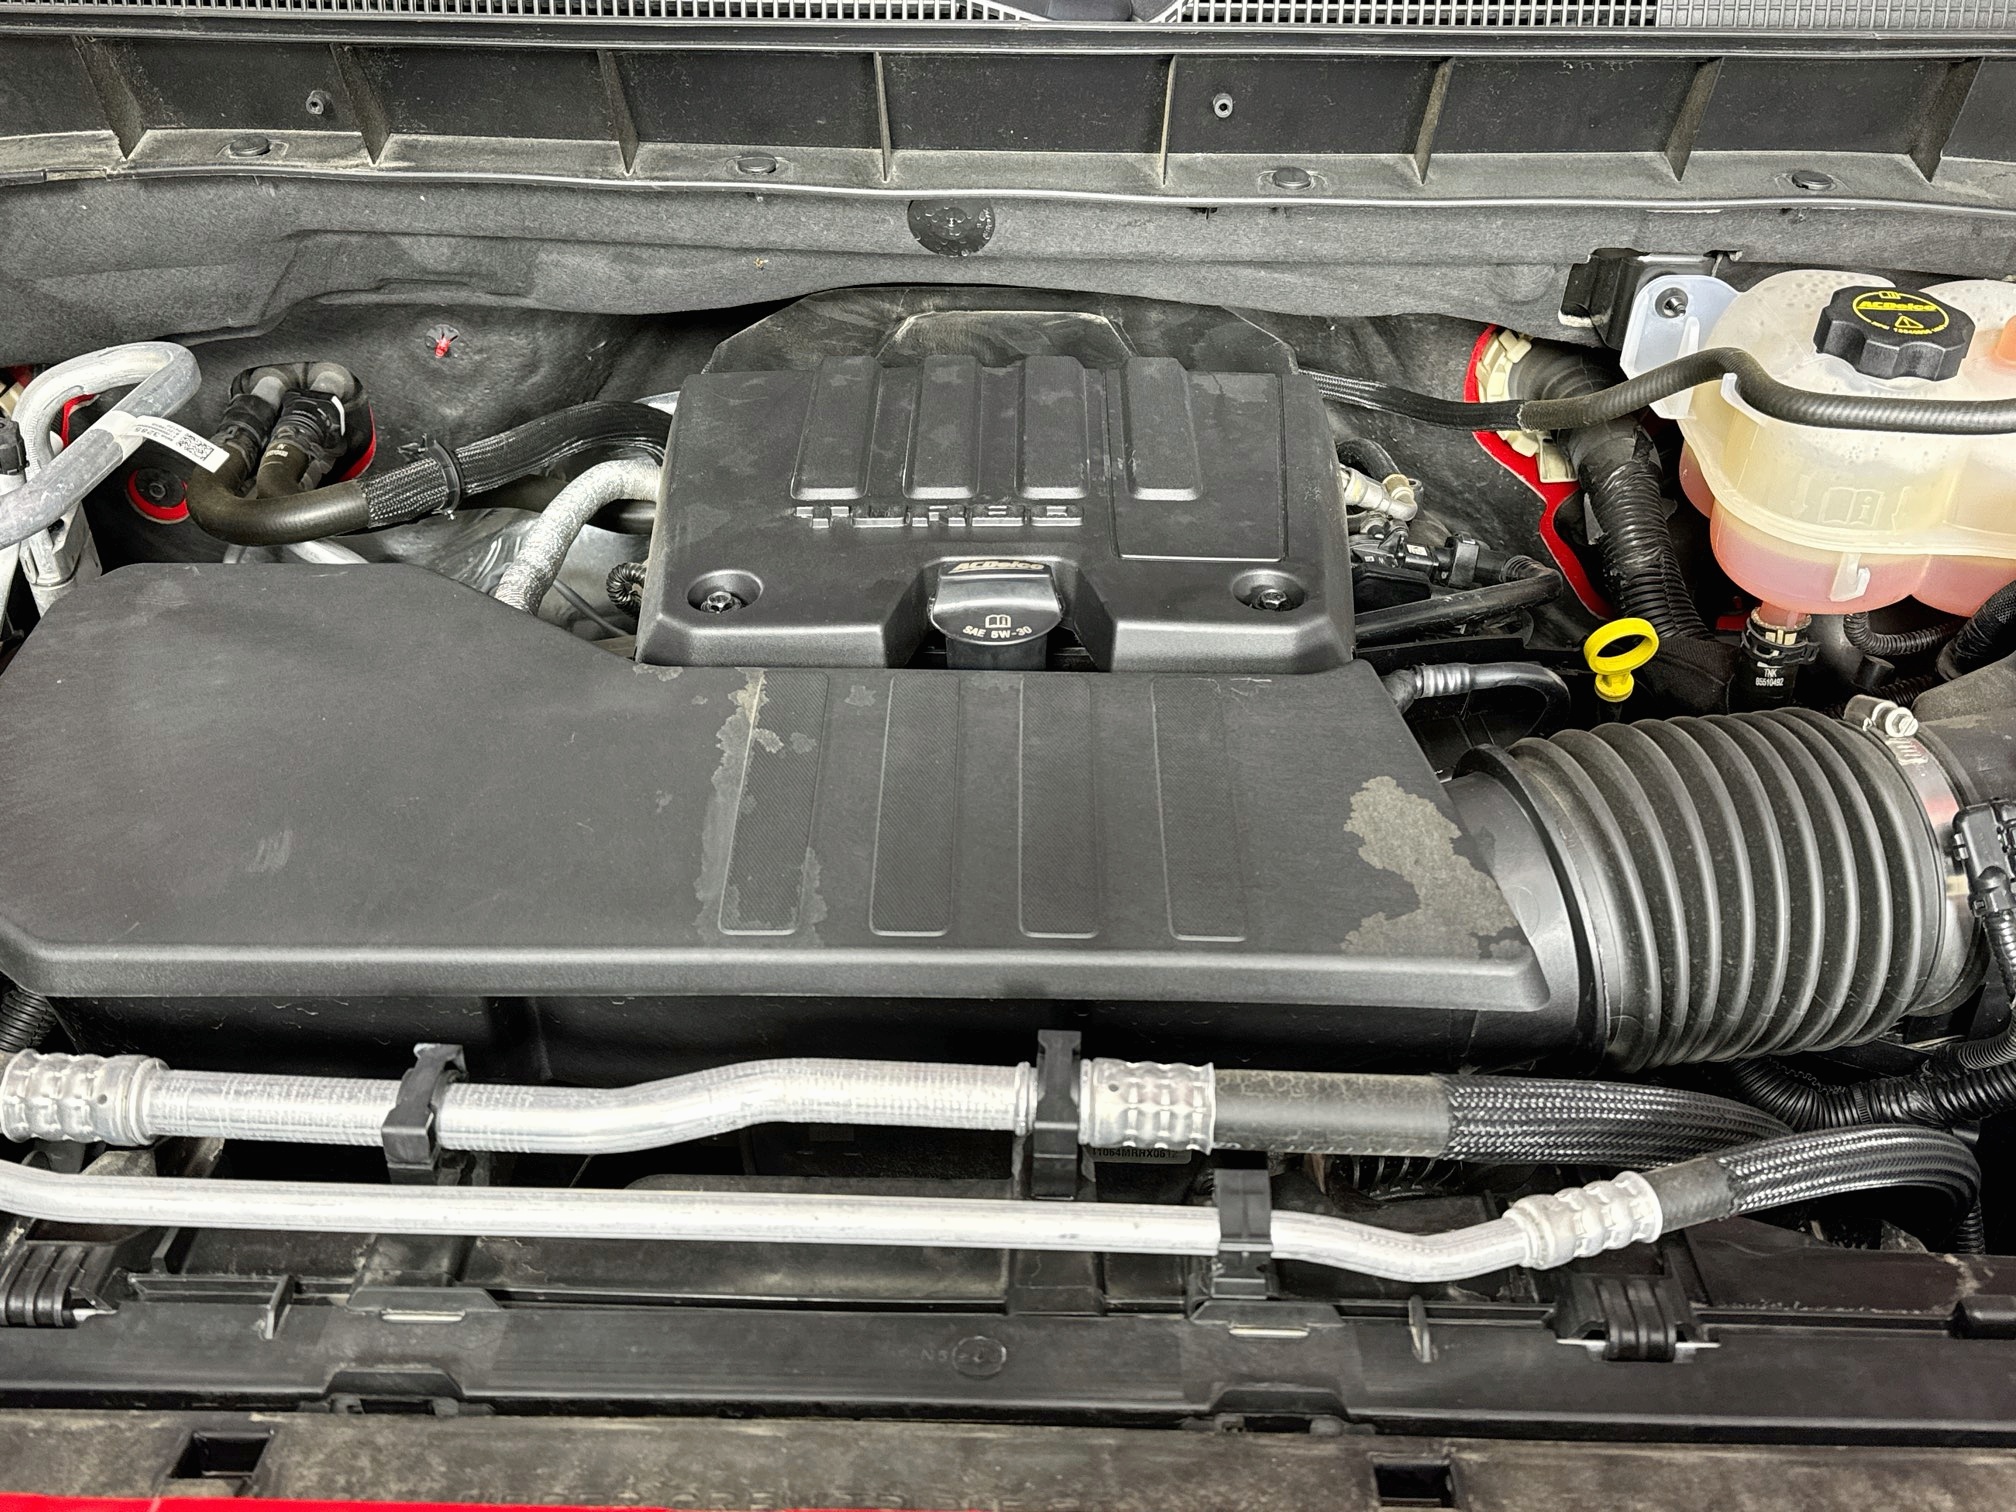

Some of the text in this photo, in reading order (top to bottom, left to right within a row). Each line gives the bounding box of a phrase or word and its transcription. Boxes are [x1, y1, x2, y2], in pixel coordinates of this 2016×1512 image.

[1857, 301, 1937, 312] ACDelco
[950, 560, 1045, 573] ACDelco
[962, 625, 1033, 639] SAE 5W-30
